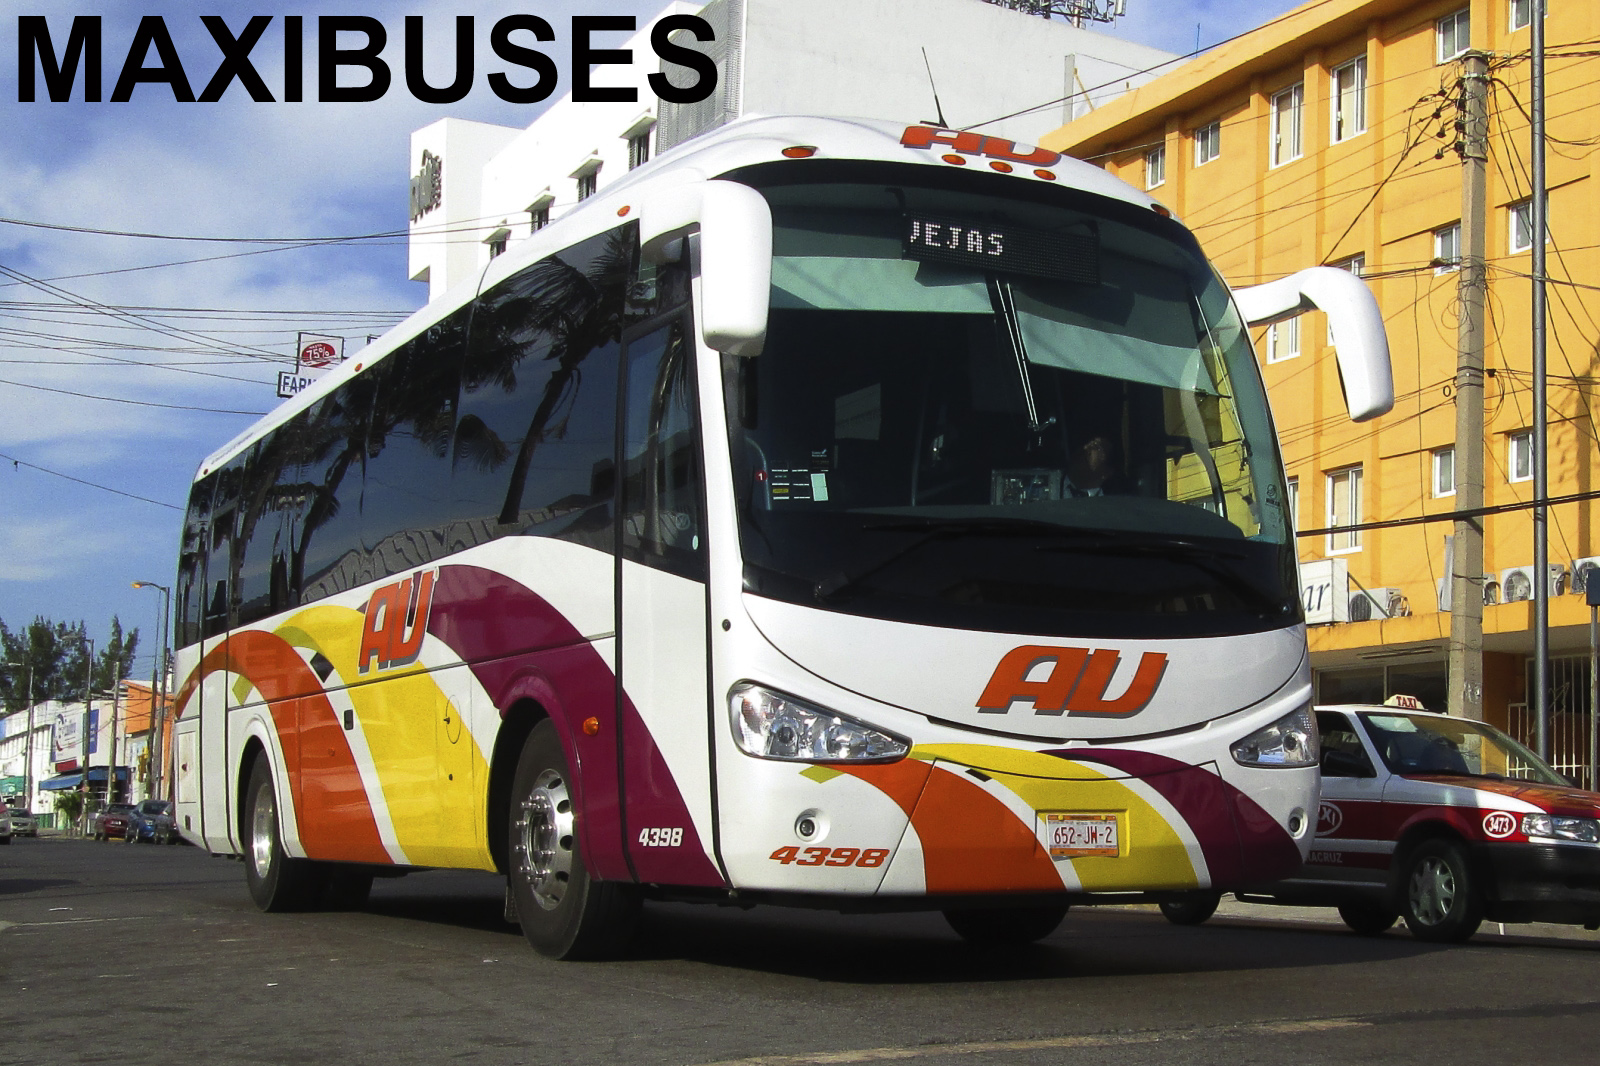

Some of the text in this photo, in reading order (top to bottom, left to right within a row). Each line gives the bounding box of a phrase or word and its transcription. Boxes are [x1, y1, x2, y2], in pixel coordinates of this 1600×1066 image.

[900, 126, 1062, 167] AU
[306, 346, 330, 360] 75%
[282, 375, 317, 393] FAR
[358, 569, 438, 675] AU
[975, 645, 1170, 719] AU
[1396, 695, 1417, 709] TAXI
[1320, 806, 1336, 826] XI
[1488, 816, 1510, 833] 3473
[638, 827, 683, 847] 4398
[768, 845, 890, 868] 4398
